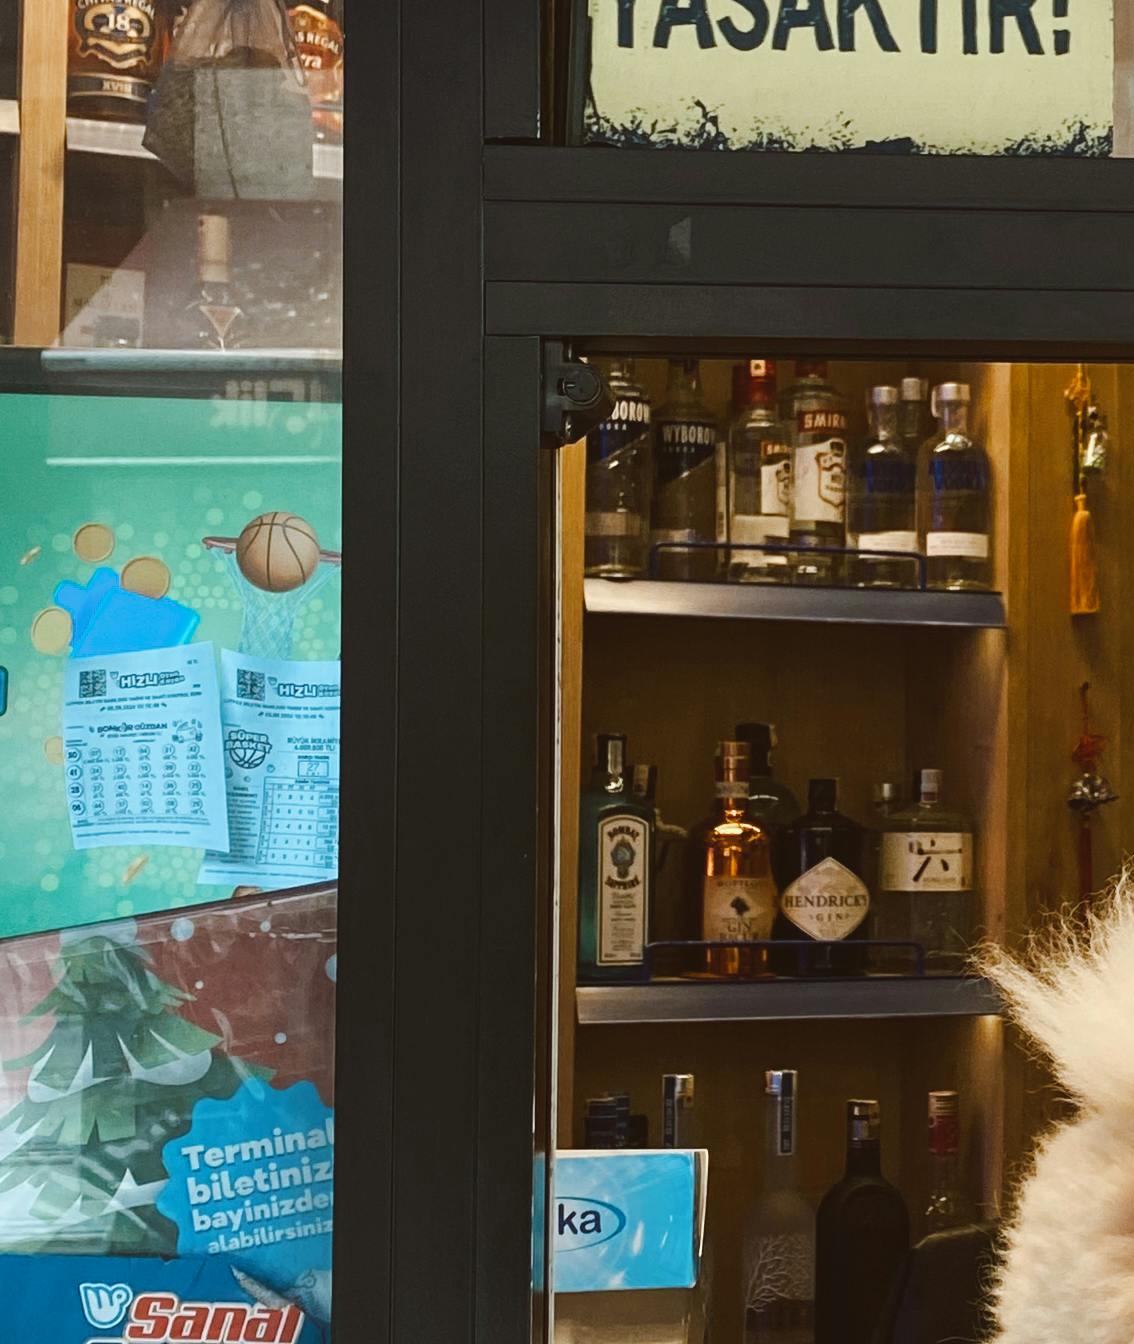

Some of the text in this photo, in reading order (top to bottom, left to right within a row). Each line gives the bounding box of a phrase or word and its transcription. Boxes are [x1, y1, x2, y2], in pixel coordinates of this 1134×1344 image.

[107, 13, 131, 32] 18
[120, 673, 159, 688] HIZLI
[278, 683, 318, 698] HIZLI
[181, 1117, 334, 1171] Terminal
[192, 1188, 333, 1233] bayinizde
[208, 1216, 333, 1255] alabilirsiniz
